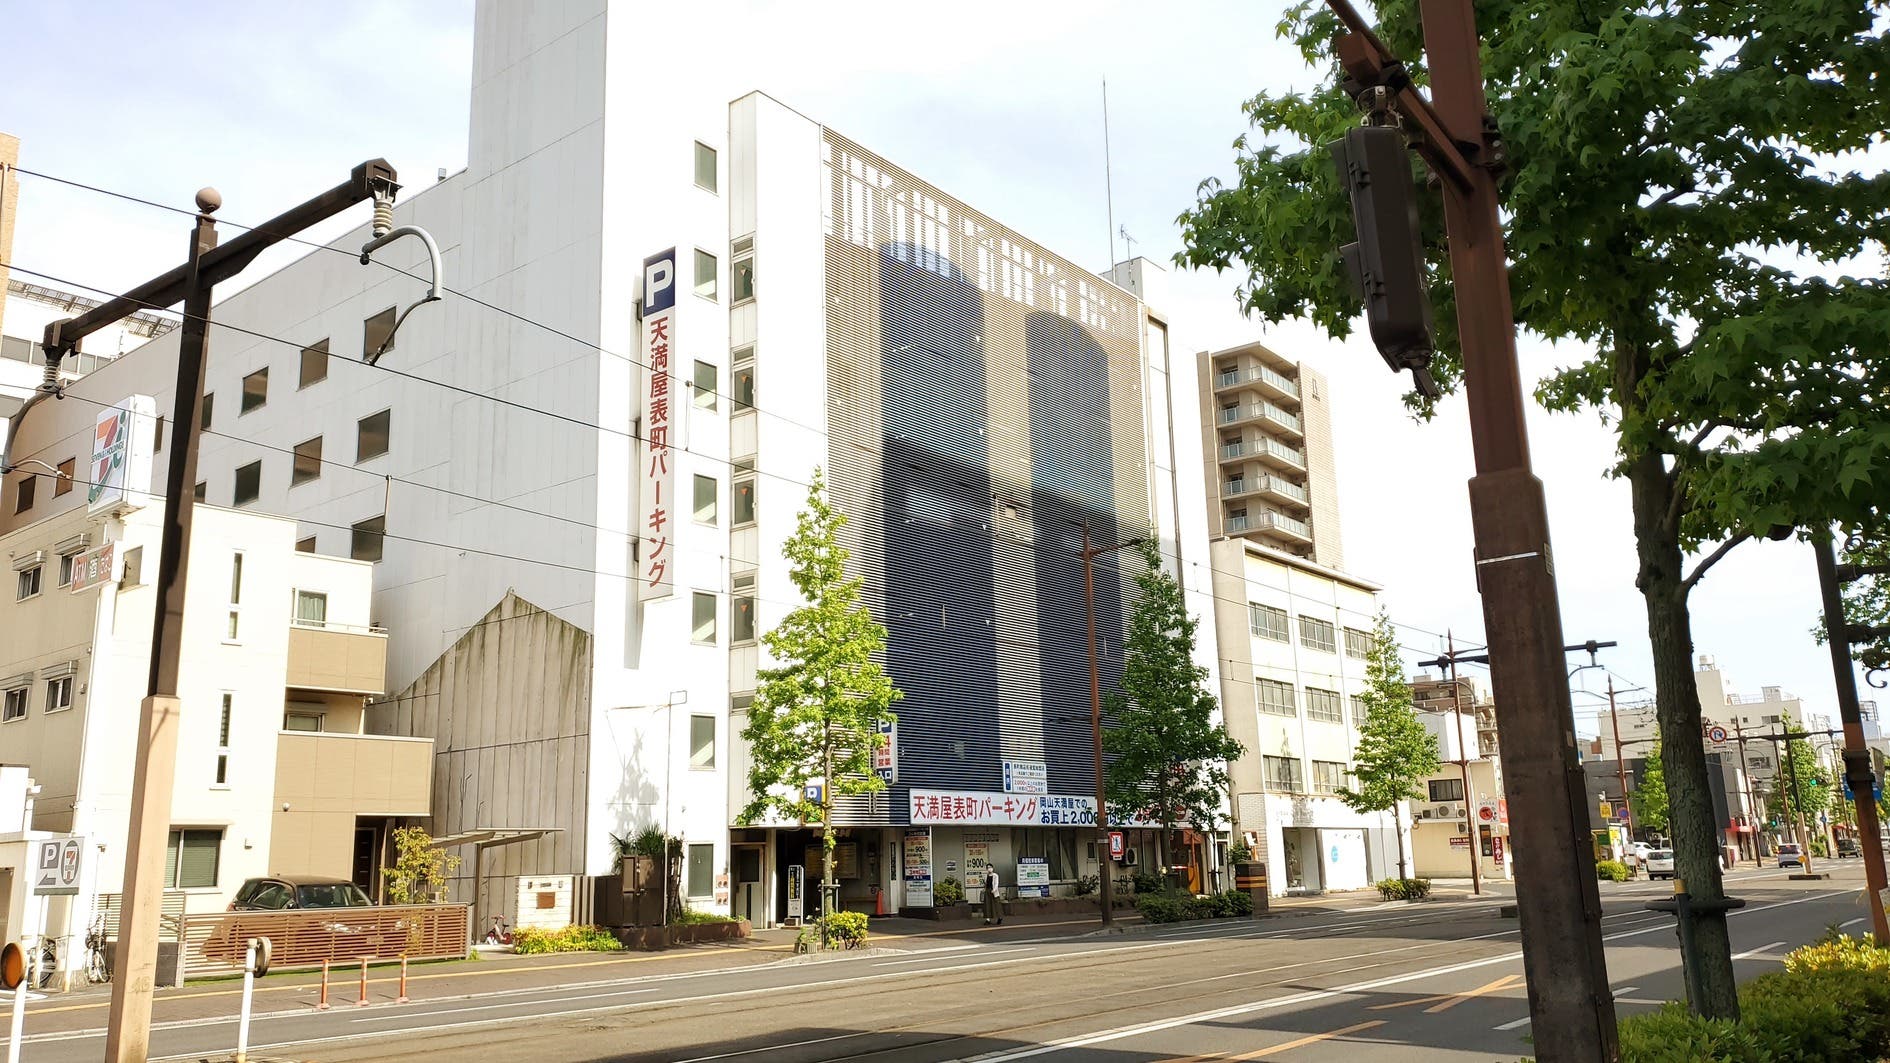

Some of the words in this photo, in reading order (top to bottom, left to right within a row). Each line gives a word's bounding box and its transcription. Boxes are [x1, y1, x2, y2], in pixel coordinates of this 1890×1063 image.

[646, 258, 674, 309] P
[649, 316, 669, 589] 天満屋表町パーキング
[878, 718, 890, 731] P
[913, 795, 1038, 821] 天満屋表町パーキング
[1039, 796, 1088, 809] 岡山天満屋での
[44, 844, 58, 868] P
[972, 858, 984, 868] 900
